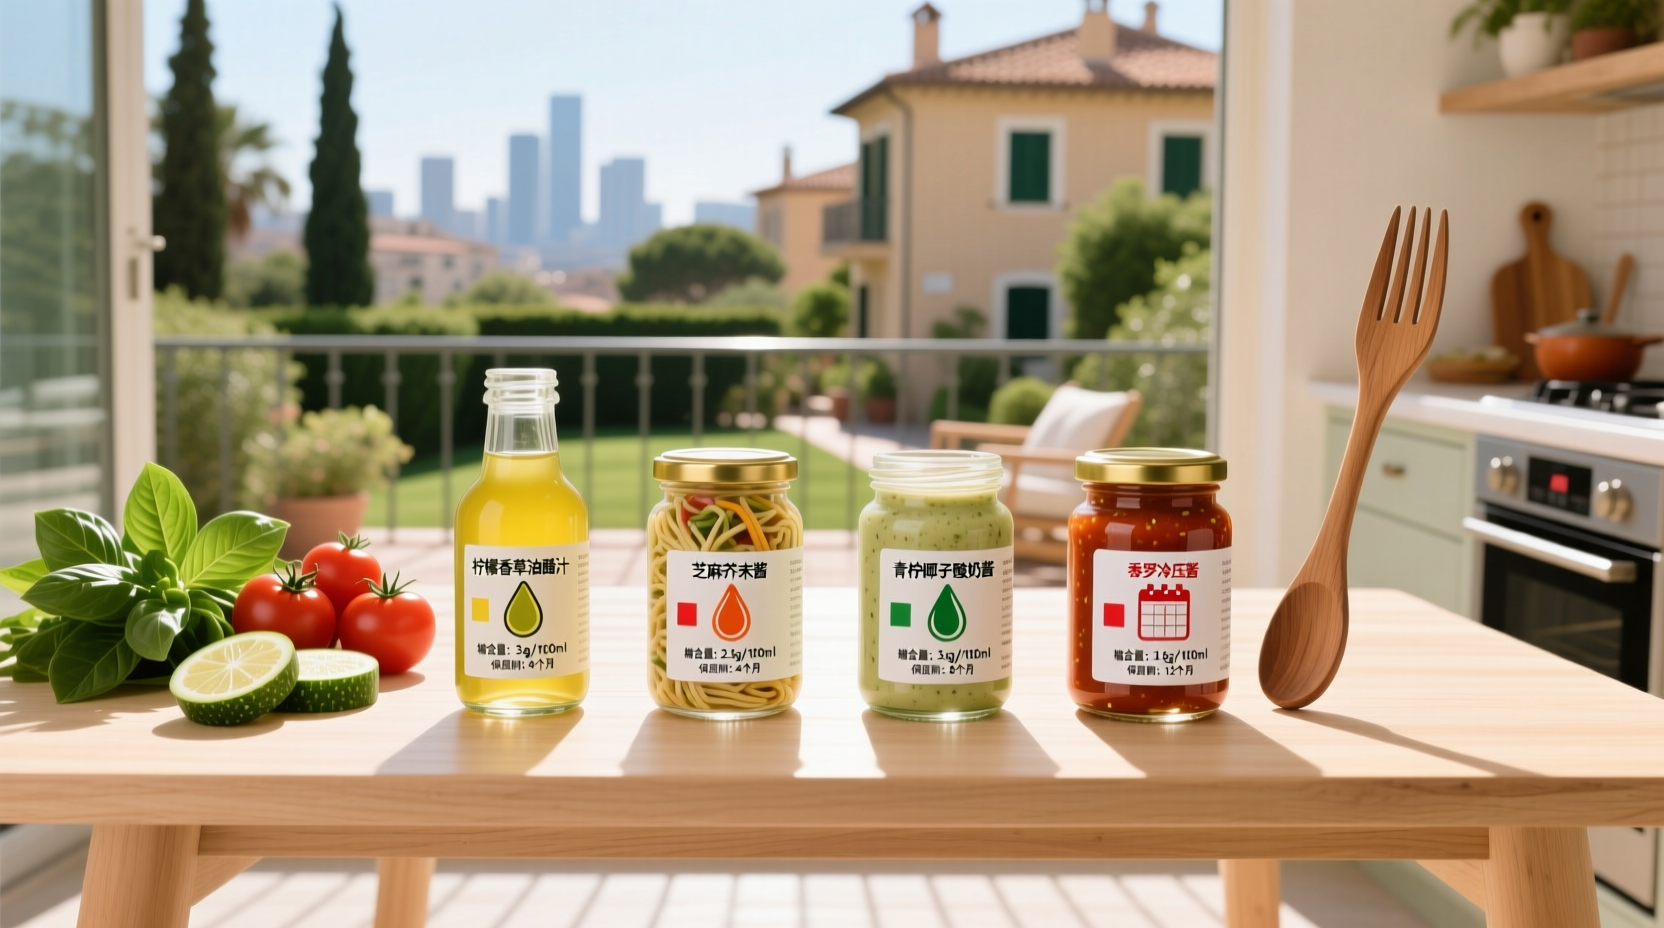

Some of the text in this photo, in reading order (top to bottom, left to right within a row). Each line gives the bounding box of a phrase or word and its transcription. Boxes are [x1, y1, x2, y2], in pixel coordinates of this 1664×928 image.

[691, 561, 768, 580] 芝麻芥末酱
